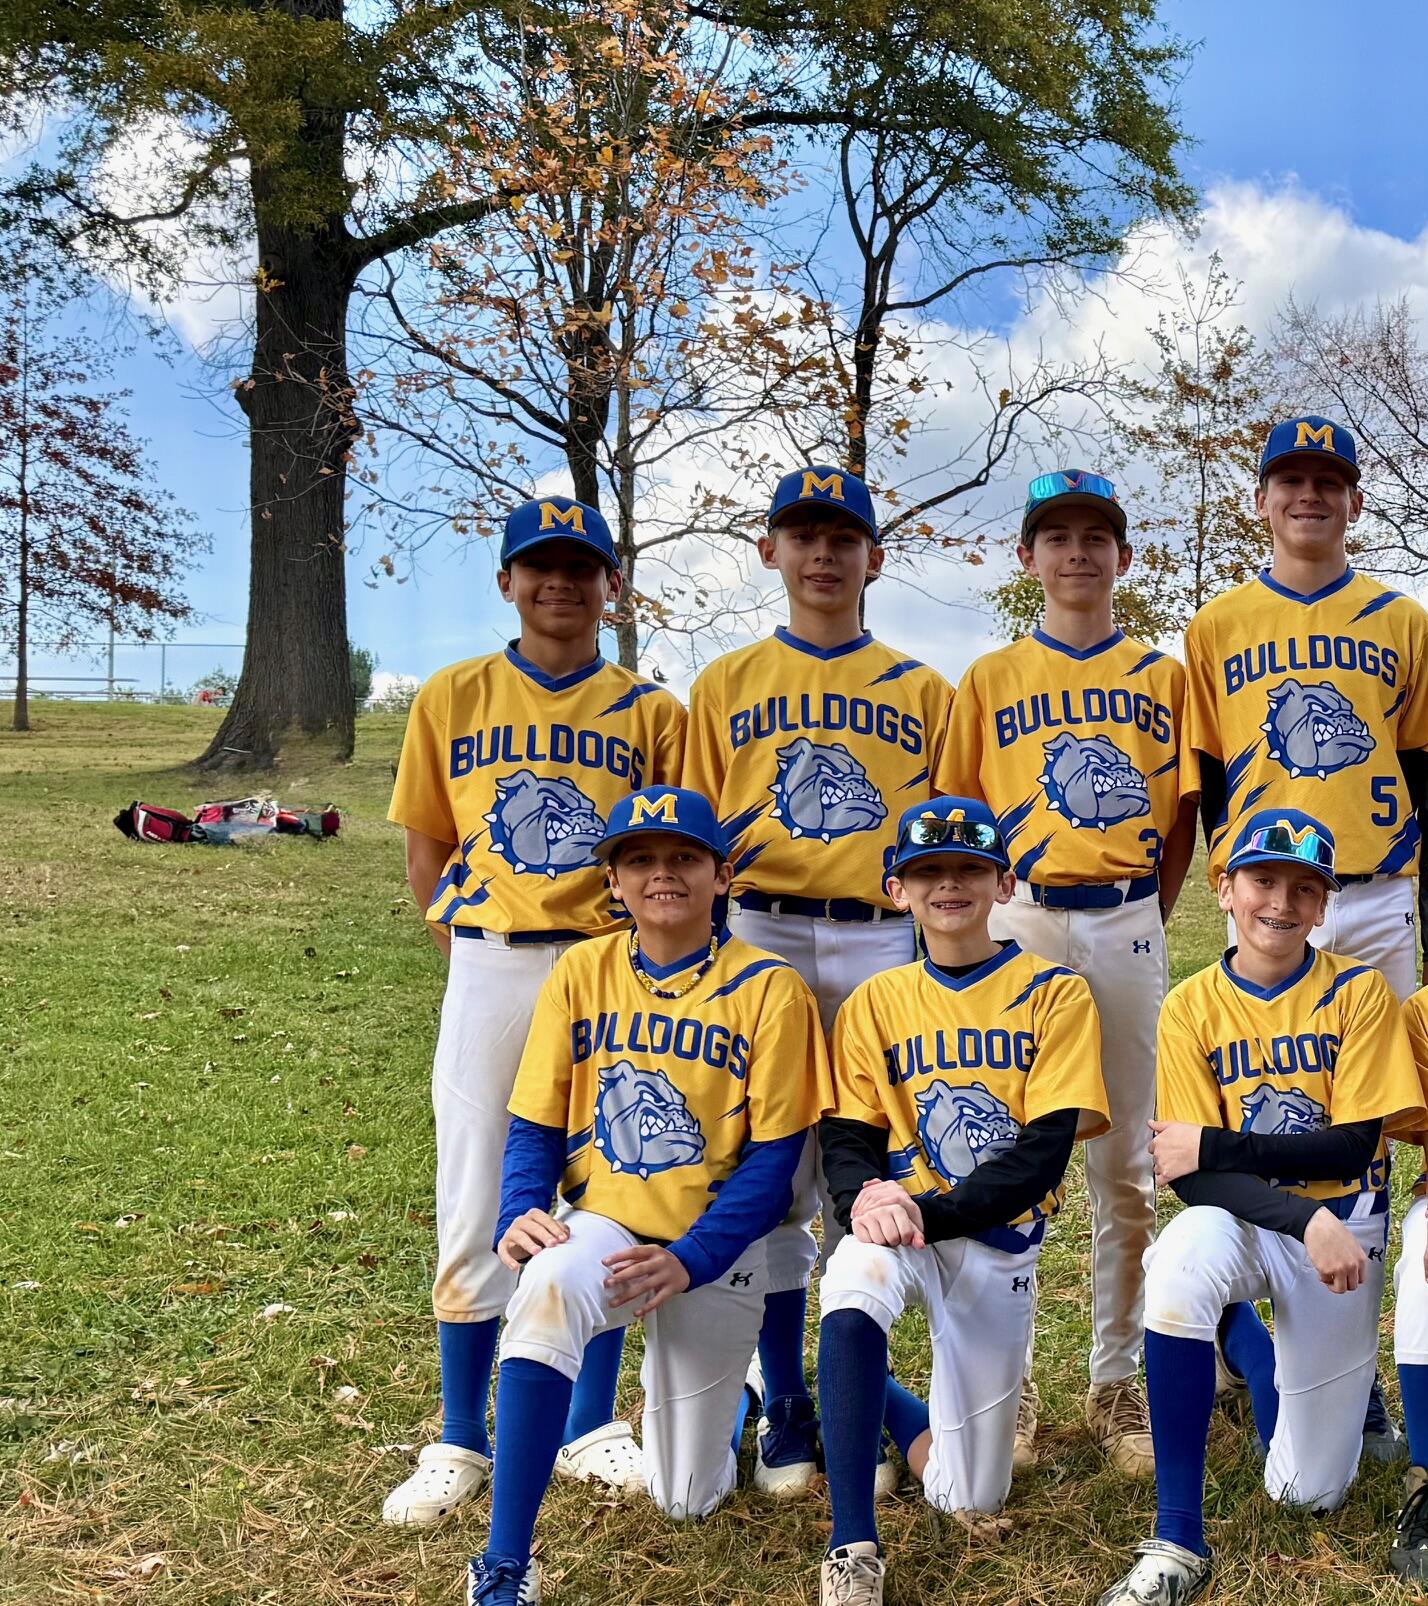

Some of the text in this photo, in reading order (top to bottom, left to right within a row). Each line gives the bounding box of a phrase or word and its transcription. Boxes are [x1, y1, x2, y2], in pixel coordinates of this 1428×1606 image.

[1294, 421, 1336, 452] M
[799, 471, 845, 501] M
[539, 502, 587, 535] M
[1223, 635, 1400, 696] BULLDOGS
[729, 692, 923, 755] BULLDOGS
[995, 688, 1171, 748] BULLDOGS
[450, 724, 645, 790] BULLDOGS
[629, 792, 679, 827] M
[1370, 776, 1397, 827] 5
